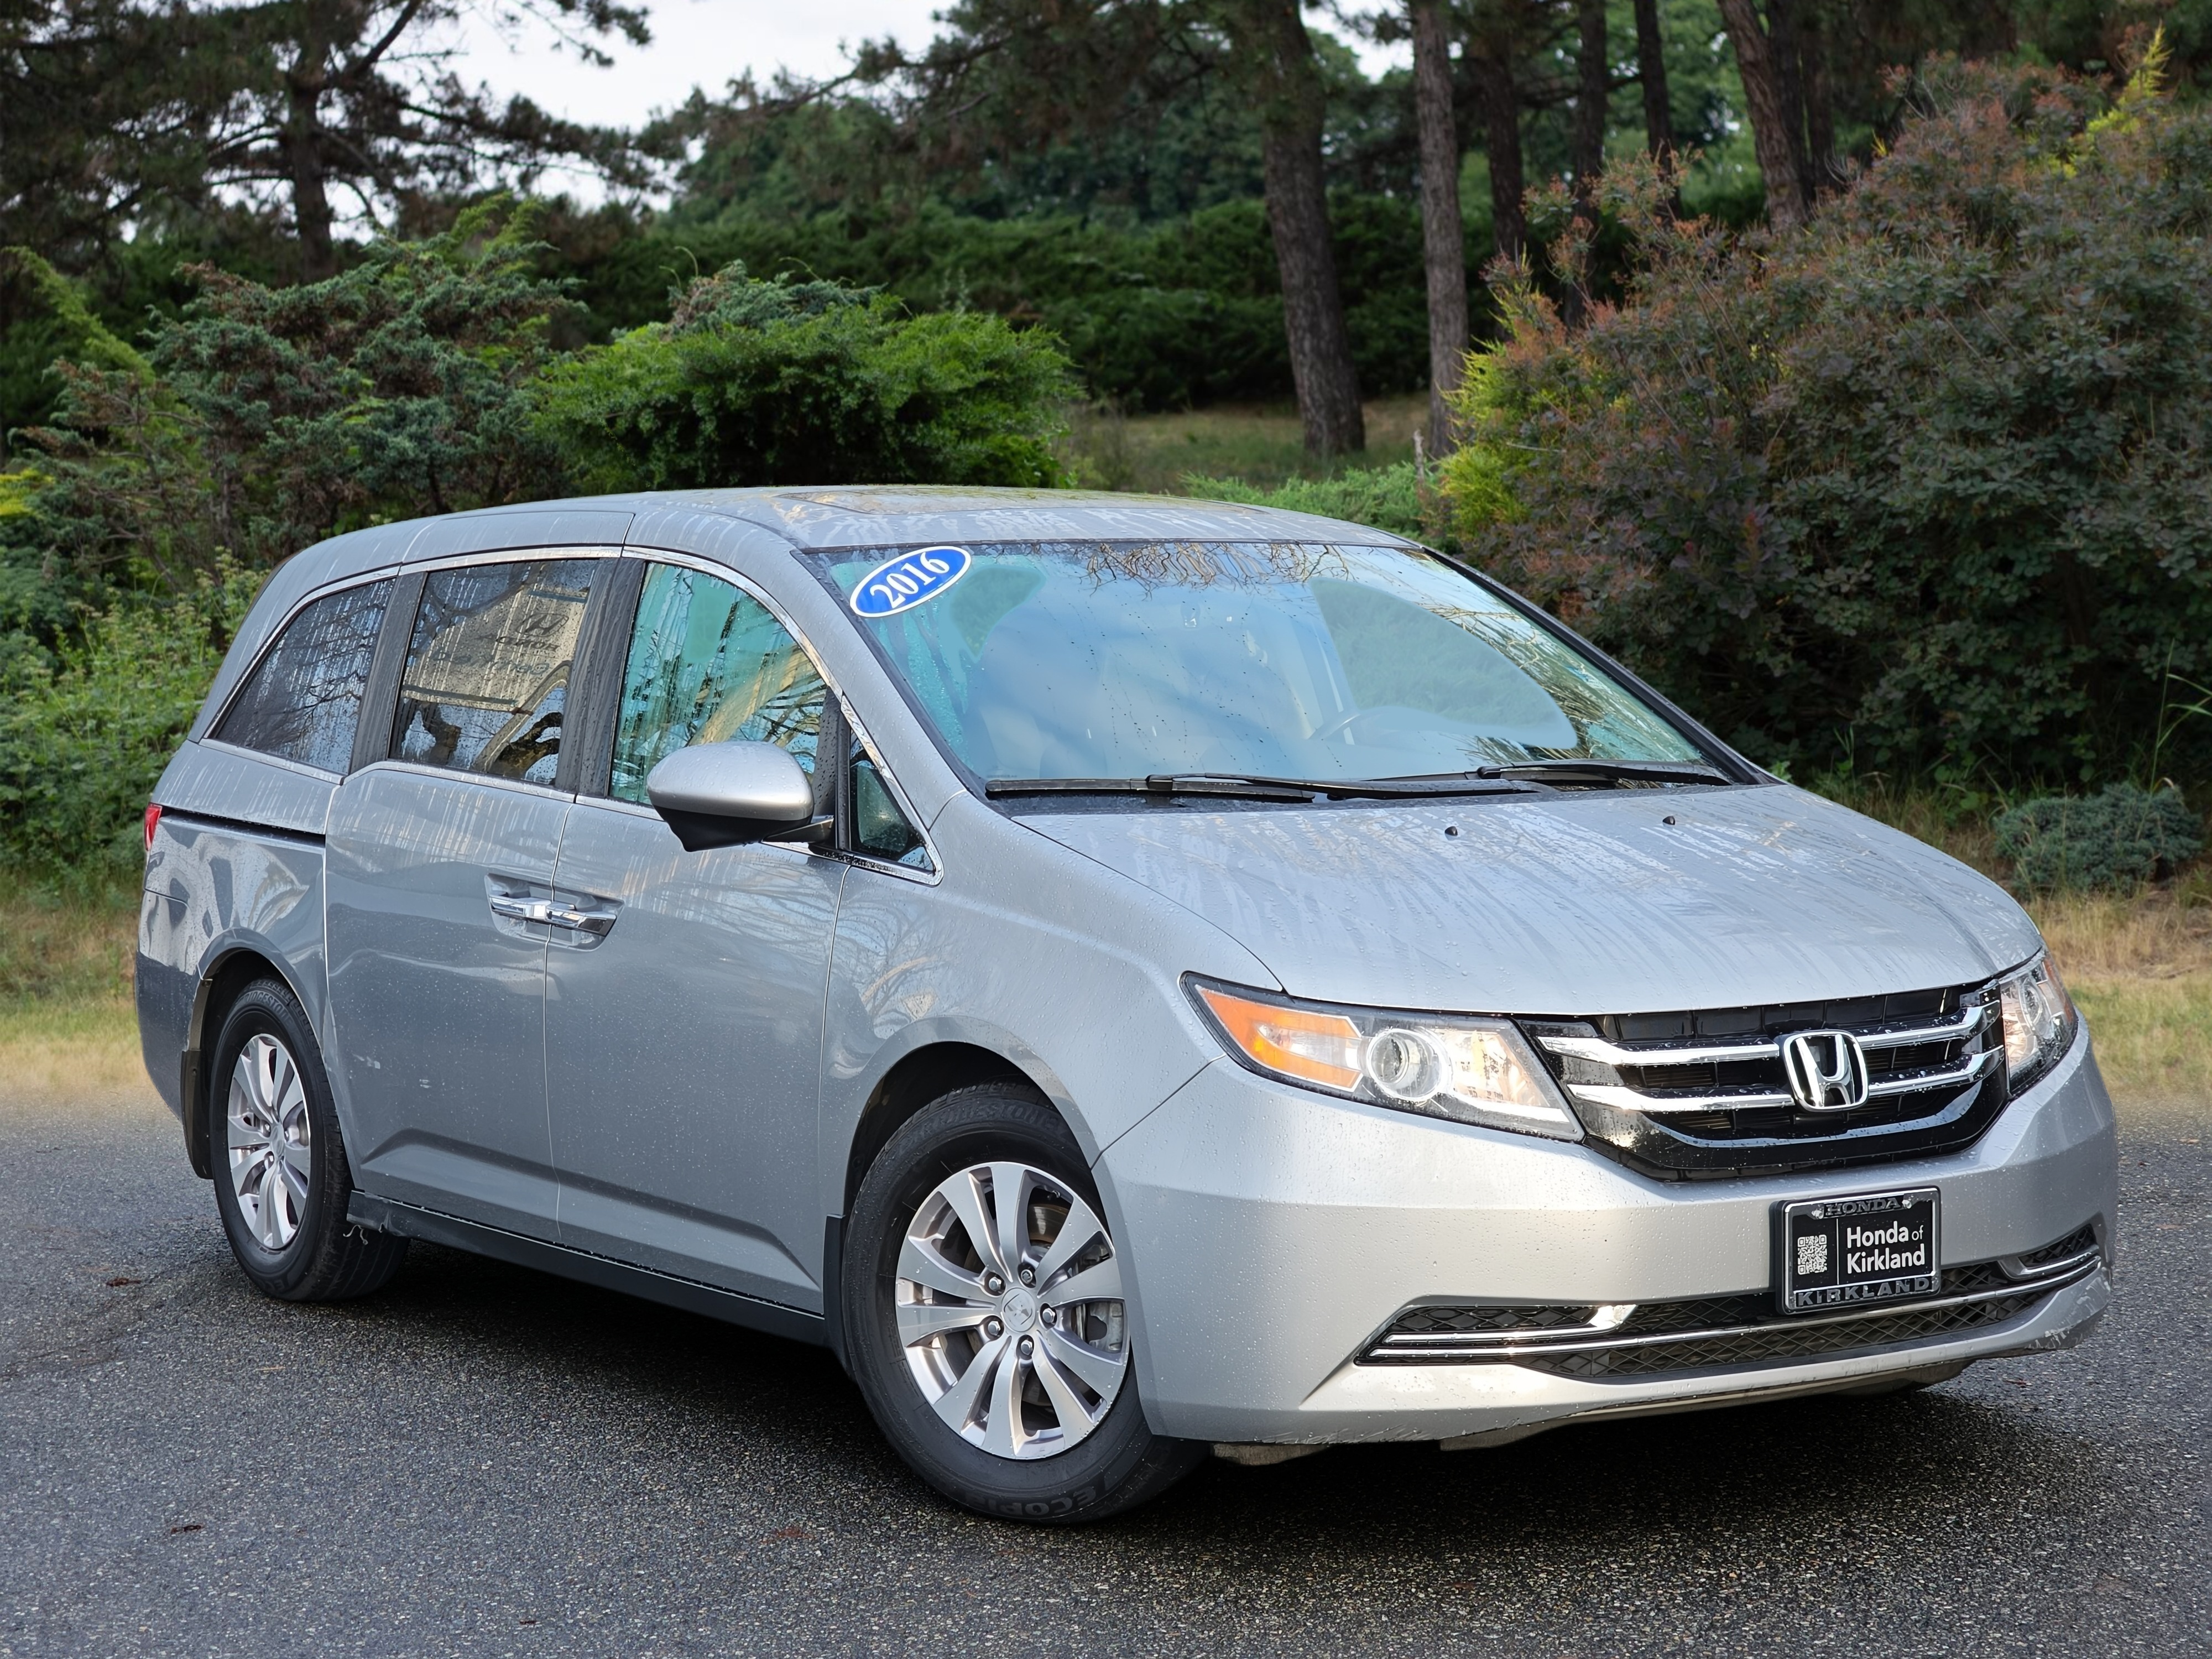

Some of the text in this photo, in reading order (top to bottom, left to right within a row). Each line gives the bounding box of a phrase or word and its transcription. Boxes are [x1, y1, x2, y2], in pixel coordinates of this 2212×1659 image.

[869, 551, 950, 609] 2016
[1825, 1197, 1901, 1217] HONDA
[1846, 1220, 1924, 1249] Honda of
[1847, 1243, 1926, 1274] Kirkland
[1798, 1277, 1930, 1307] KIRKLAND
